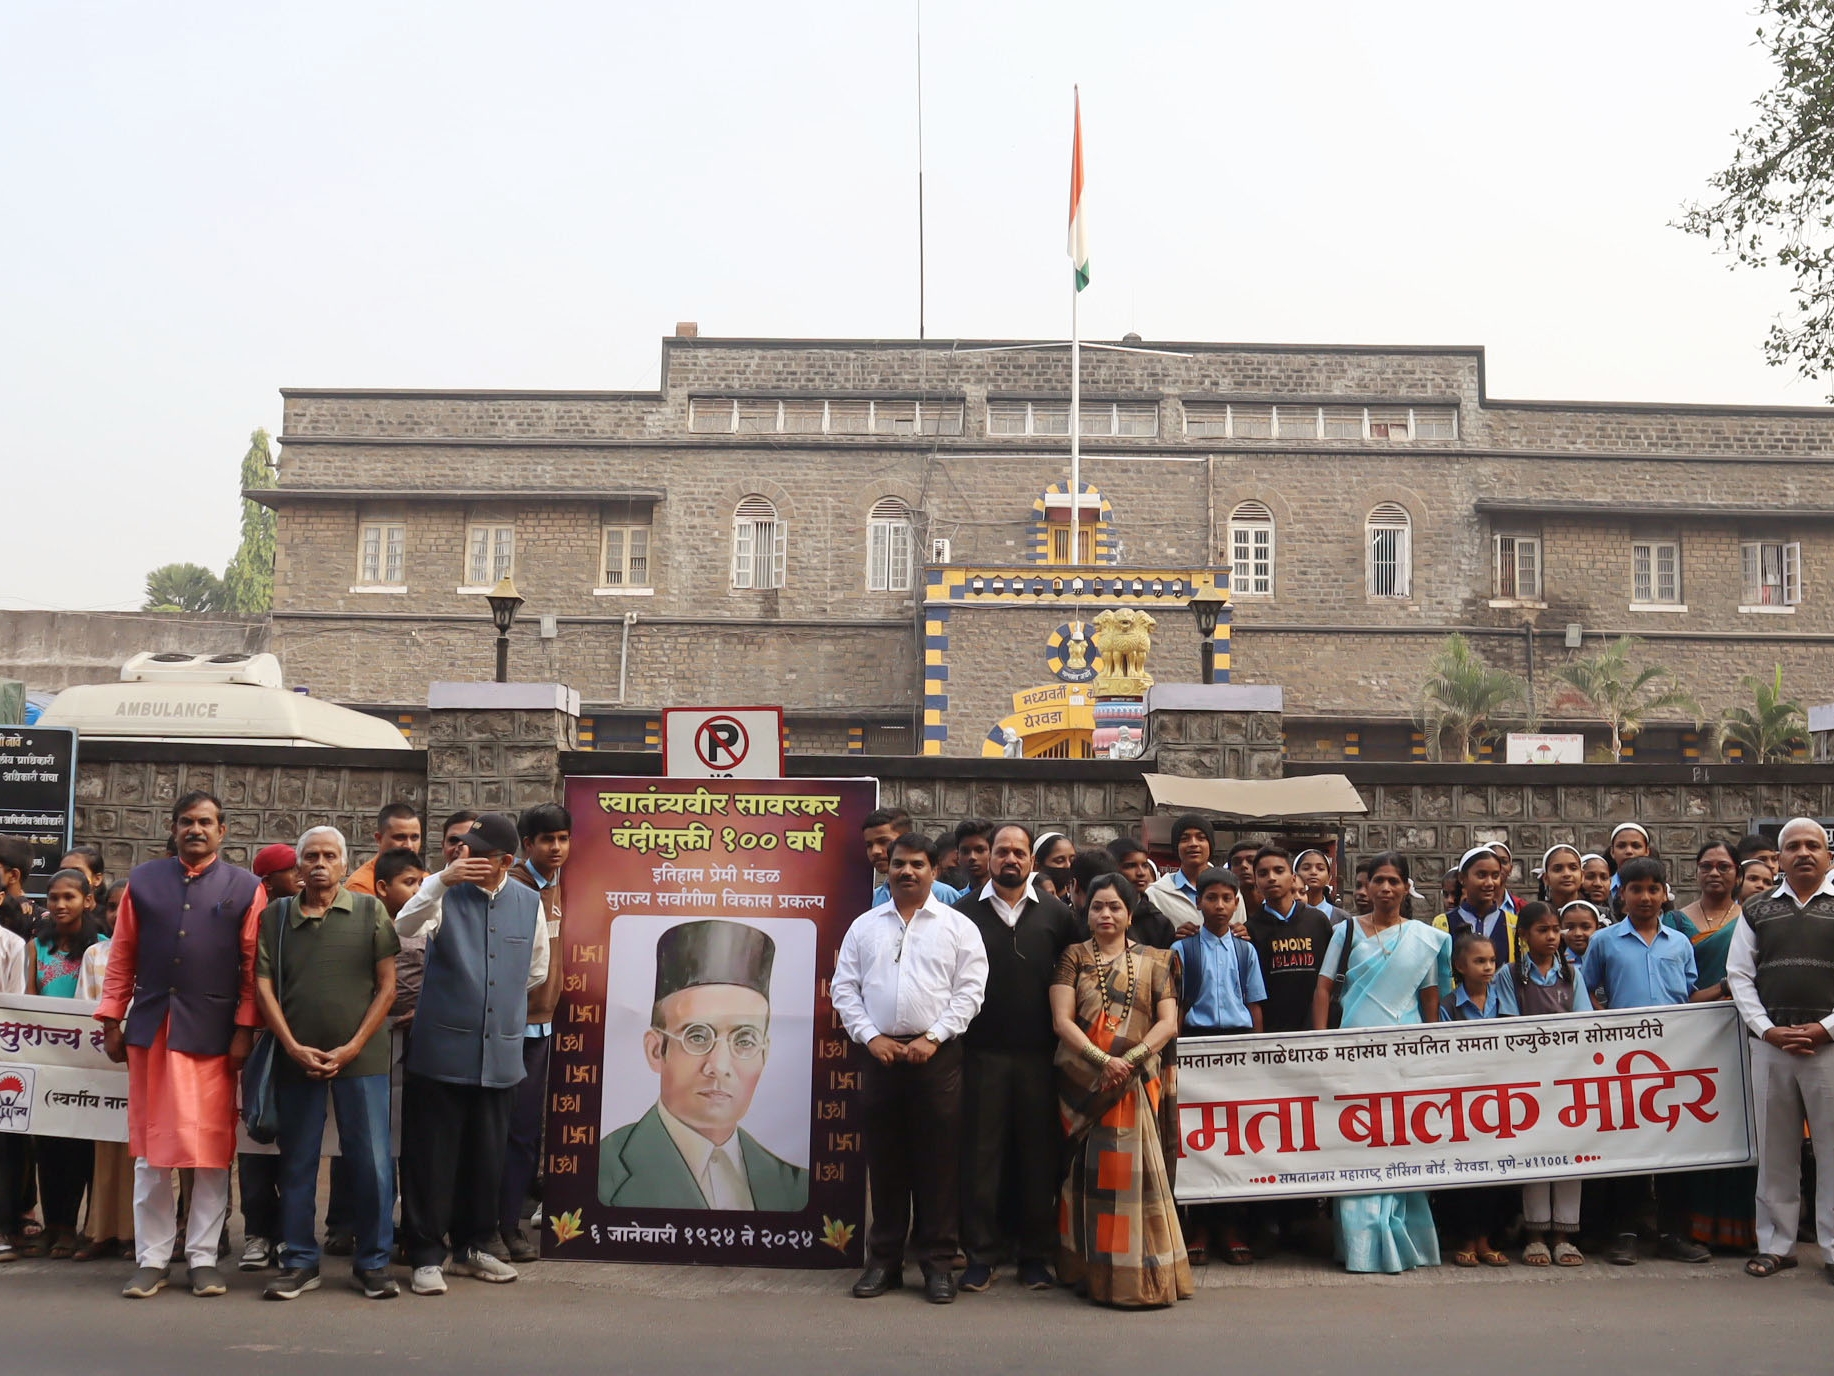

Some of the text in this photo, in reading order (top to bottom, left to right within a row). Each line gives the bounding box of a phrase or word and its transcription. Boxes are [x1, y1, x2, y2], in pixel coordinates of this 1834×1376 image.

[1023, 684, 1067, 705] मध्यवर्ती
[115, 701, 219, 719] AMBULANCE
[1024, 711, 1063, 728] येरवडा
[598, 786, 840, 817] स्वातंत्र्यवीर सावरकर
[611, 820, 825, 859] बंदीमुक्ती १०० वर्ष
[652, 862, 781, 884] इतिहास प्रेमी मंडळ
[605, 890, 651, 911] सुराज्य
[722, 887, 772, 908] विकास
[778, 893, 826, 909] प्रकल्प
[1272, 937, 1312, 953] RHODE
[1272, 952, 1315, 968] ISLAND
[0, 1021, 82, 1052] सुराज्य
[1252, 1044, 1329, 1065] गाळेधारक
[1335, 1038, 1387, 1062] महासंघ
[1393, 1035, 1450, 1057] संचलित
[1456, 1035, 1499, 1052] समता
[1504, 1027, 1579, 1053] एज्युकेशन
[1584, 1018, 1664, 1044] सोसायटीचे
[1177, 1049, 1719, 1158] मता बालक मंदिर
[1278, 1170, 1335, 1184] समतानगर
[1339, 1167, 1382, 1182] महाराष्ट्र
[590, 1221, 814, 1249] ६ जानेवारी १९२४ ते २०२४
